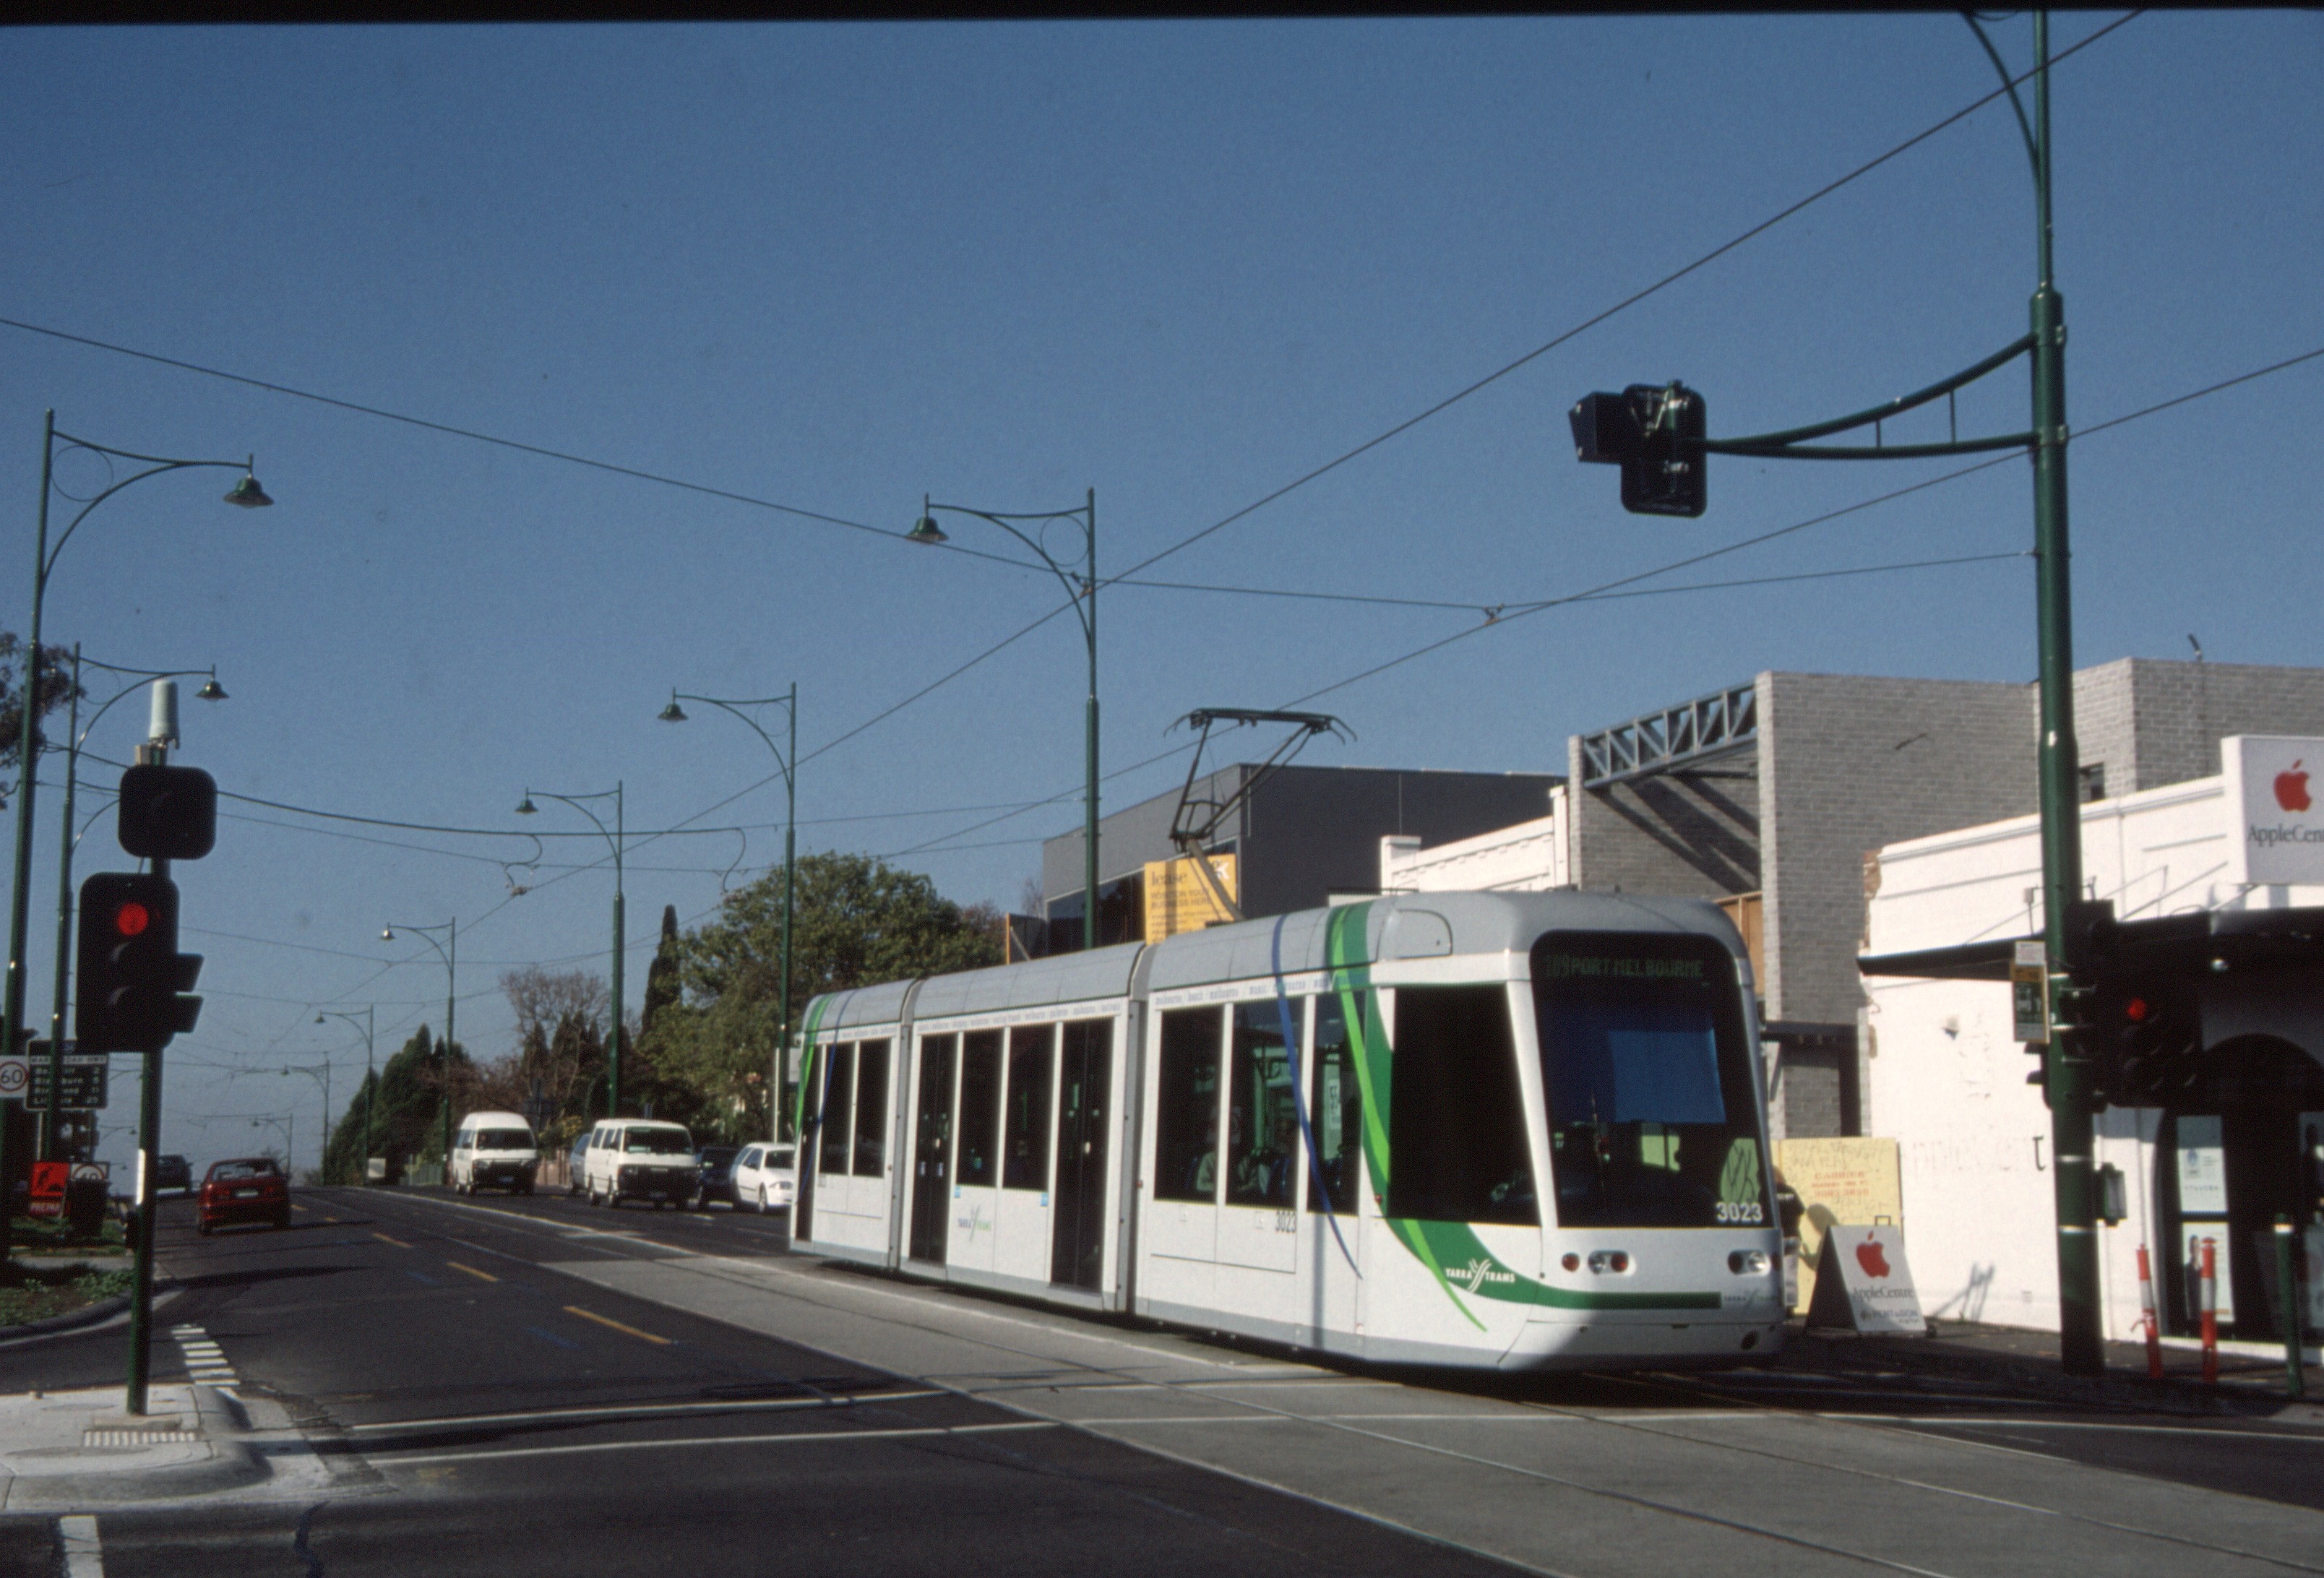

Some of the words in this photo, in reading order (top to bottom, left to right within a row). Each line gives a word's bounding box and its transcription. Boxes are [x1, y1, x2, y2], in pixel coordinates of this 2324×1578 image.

[1570, 957, 1611, 975] PORT
[1613, 958, 1704, 978] MELBOURNE
[1, 1069, 23, 1084] 60
[1275, 1211, 1296, 1233] 3023
[1716, 1202, 1763, 1223] 3023
[1445, 1267, 1473, 1279] YARRA
[1484, 1271, 1515, 1284] TRAMS
[1853, 1285, 1915, 1302] AppleCentre
